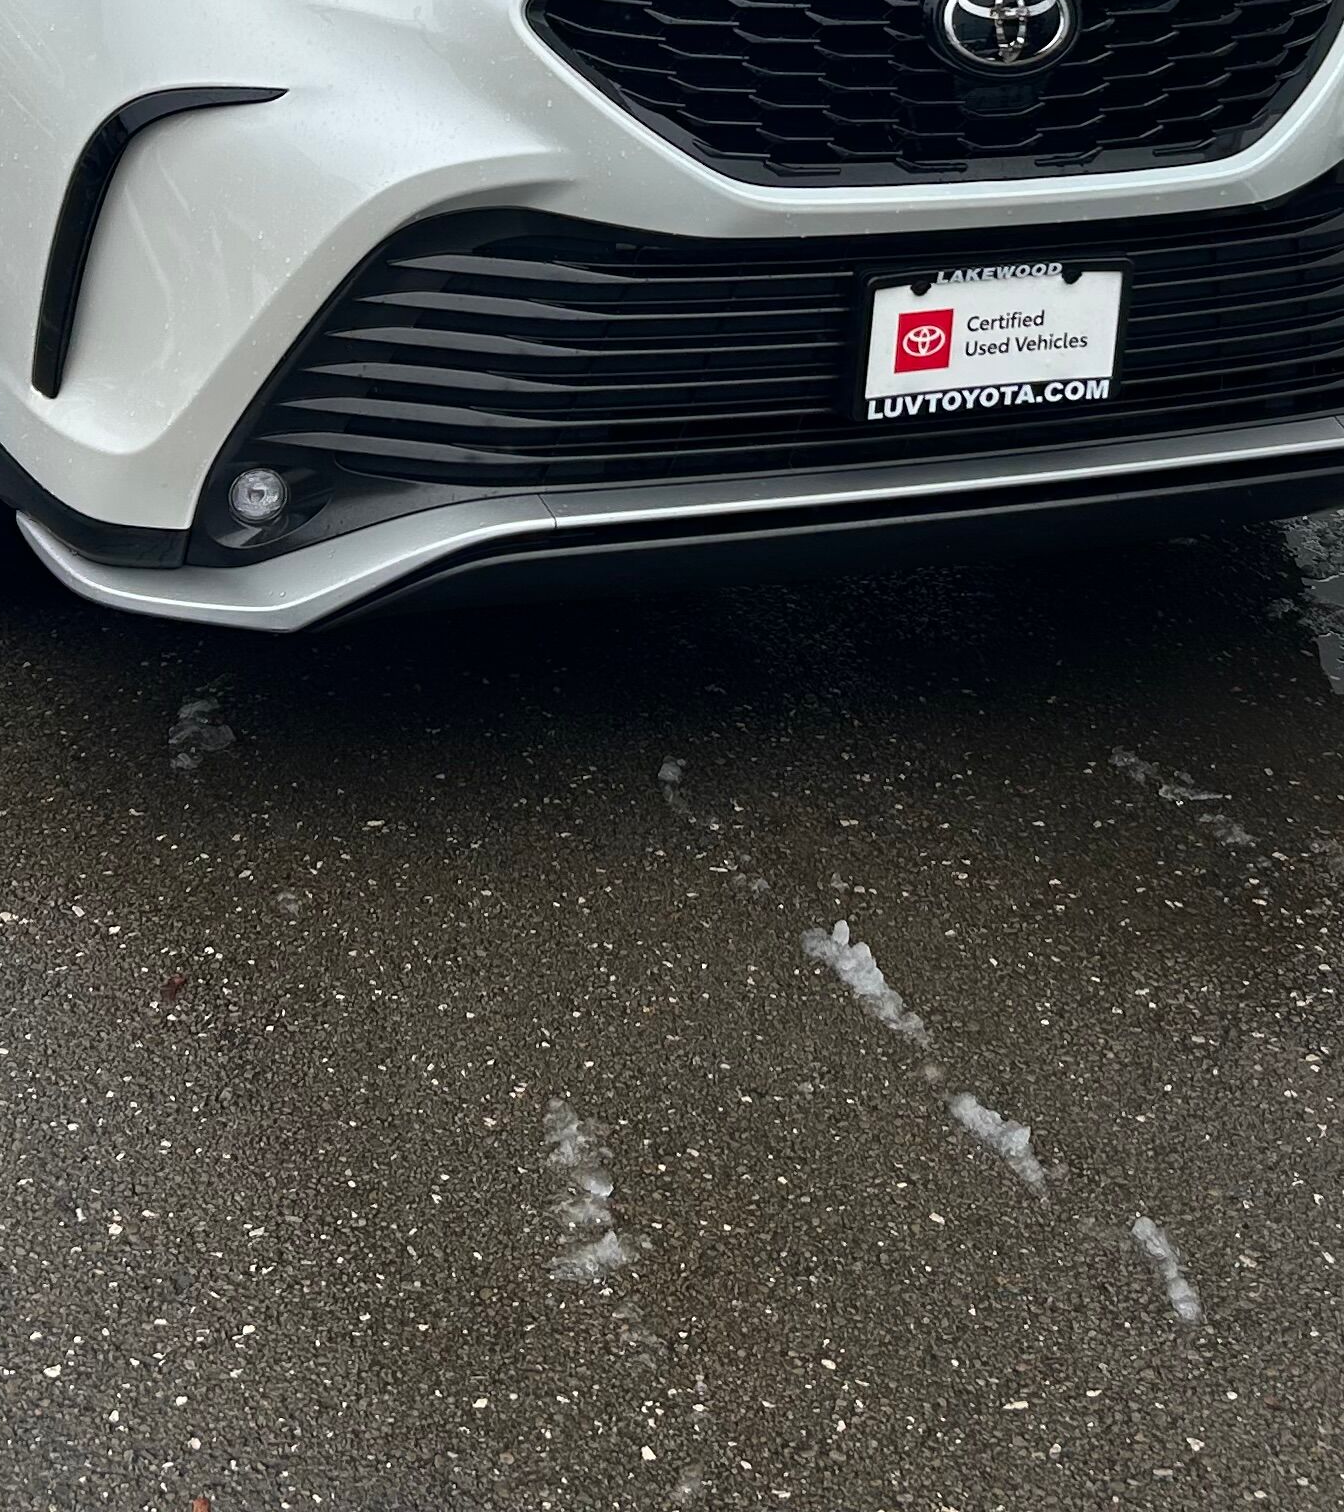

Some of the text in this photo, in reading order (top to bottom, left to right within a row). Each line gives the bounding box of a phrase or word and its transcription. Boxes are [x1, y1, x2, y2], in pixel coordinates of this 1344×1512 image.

[936, 262, 1063, 284] LAKEWOOD
[967, 310, 1045, 332] Certified
[965, 333, 1088, 356] Used Vehicles
[867, 380, 1110, 420] LUVTOYOTA.COM
